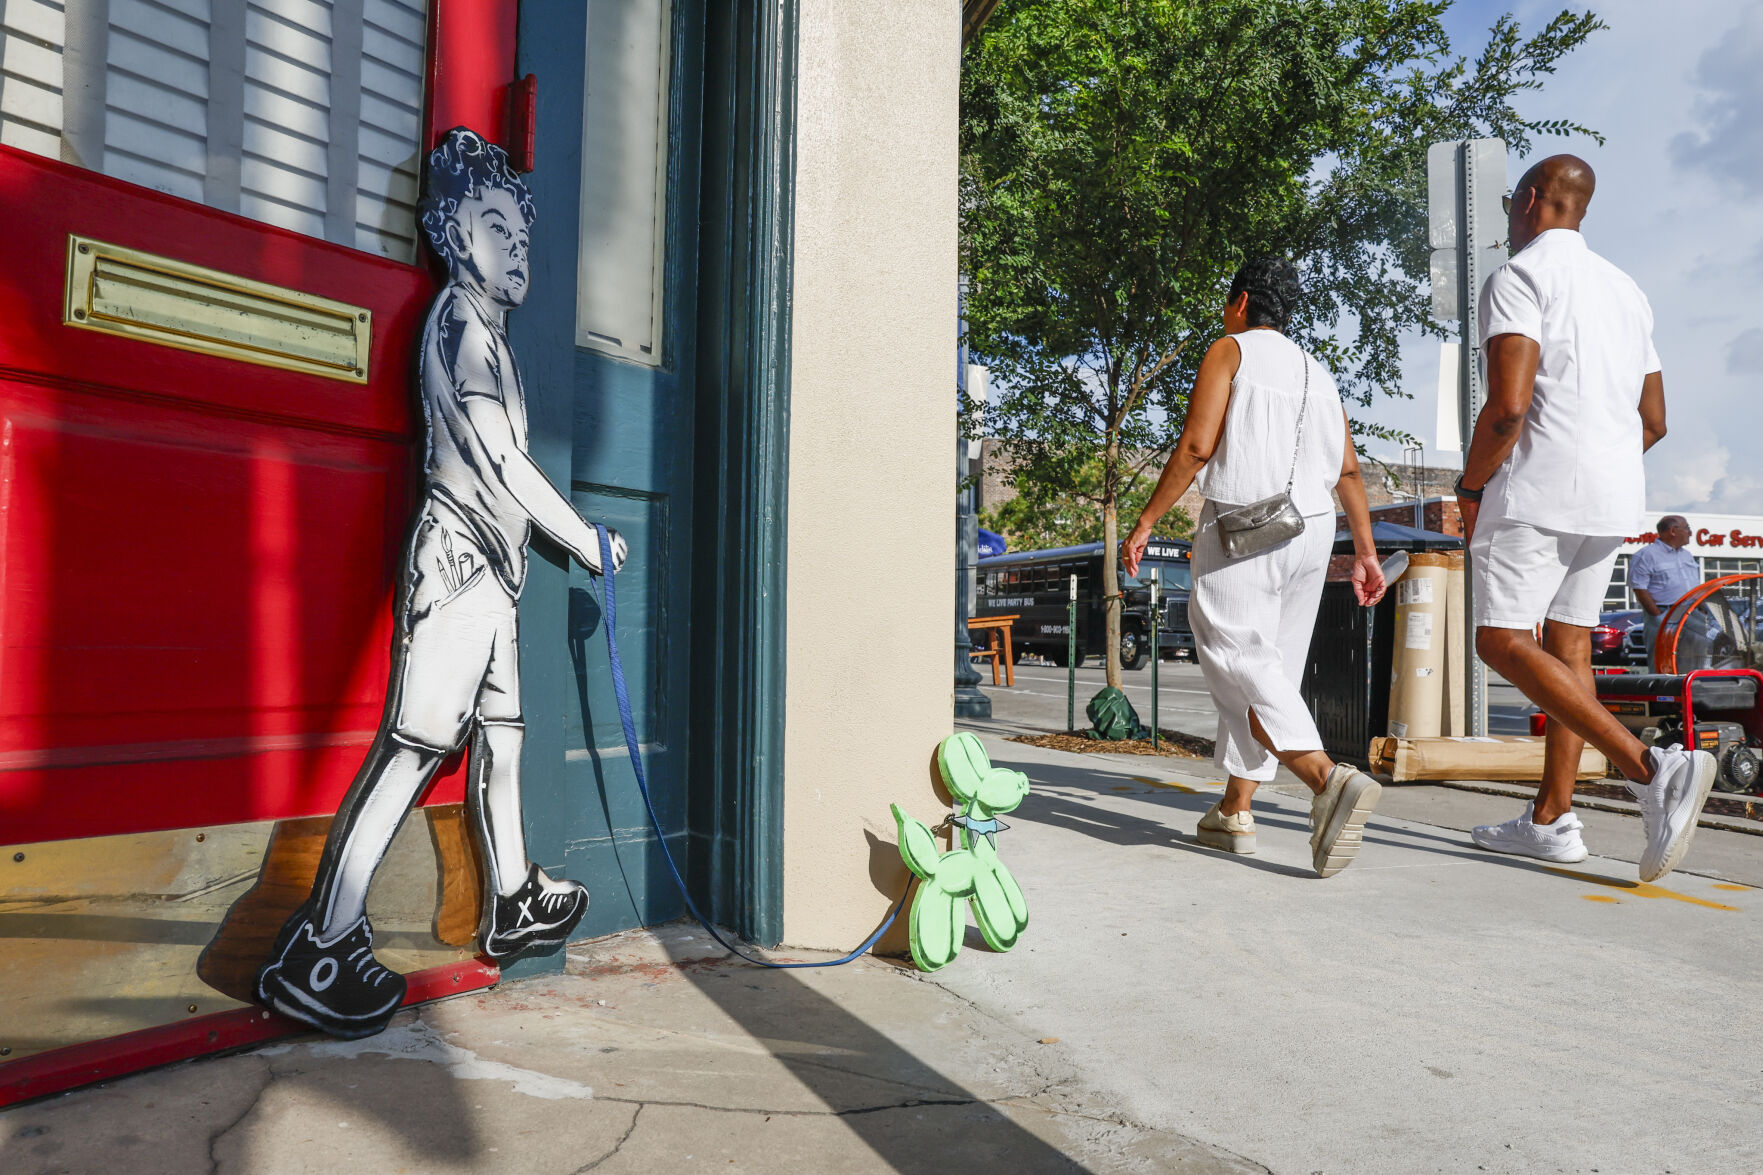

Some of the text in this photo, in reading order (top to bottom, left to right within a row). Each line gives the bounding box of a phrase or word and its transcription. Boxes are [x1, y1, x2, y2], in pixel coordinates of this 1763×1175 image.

[1696, 528, 1726, 547] Car
[1147, 546, 1179, 557] WE LIVE
[988, 597, 1035, 608] WE LIVE PARTY BUS
